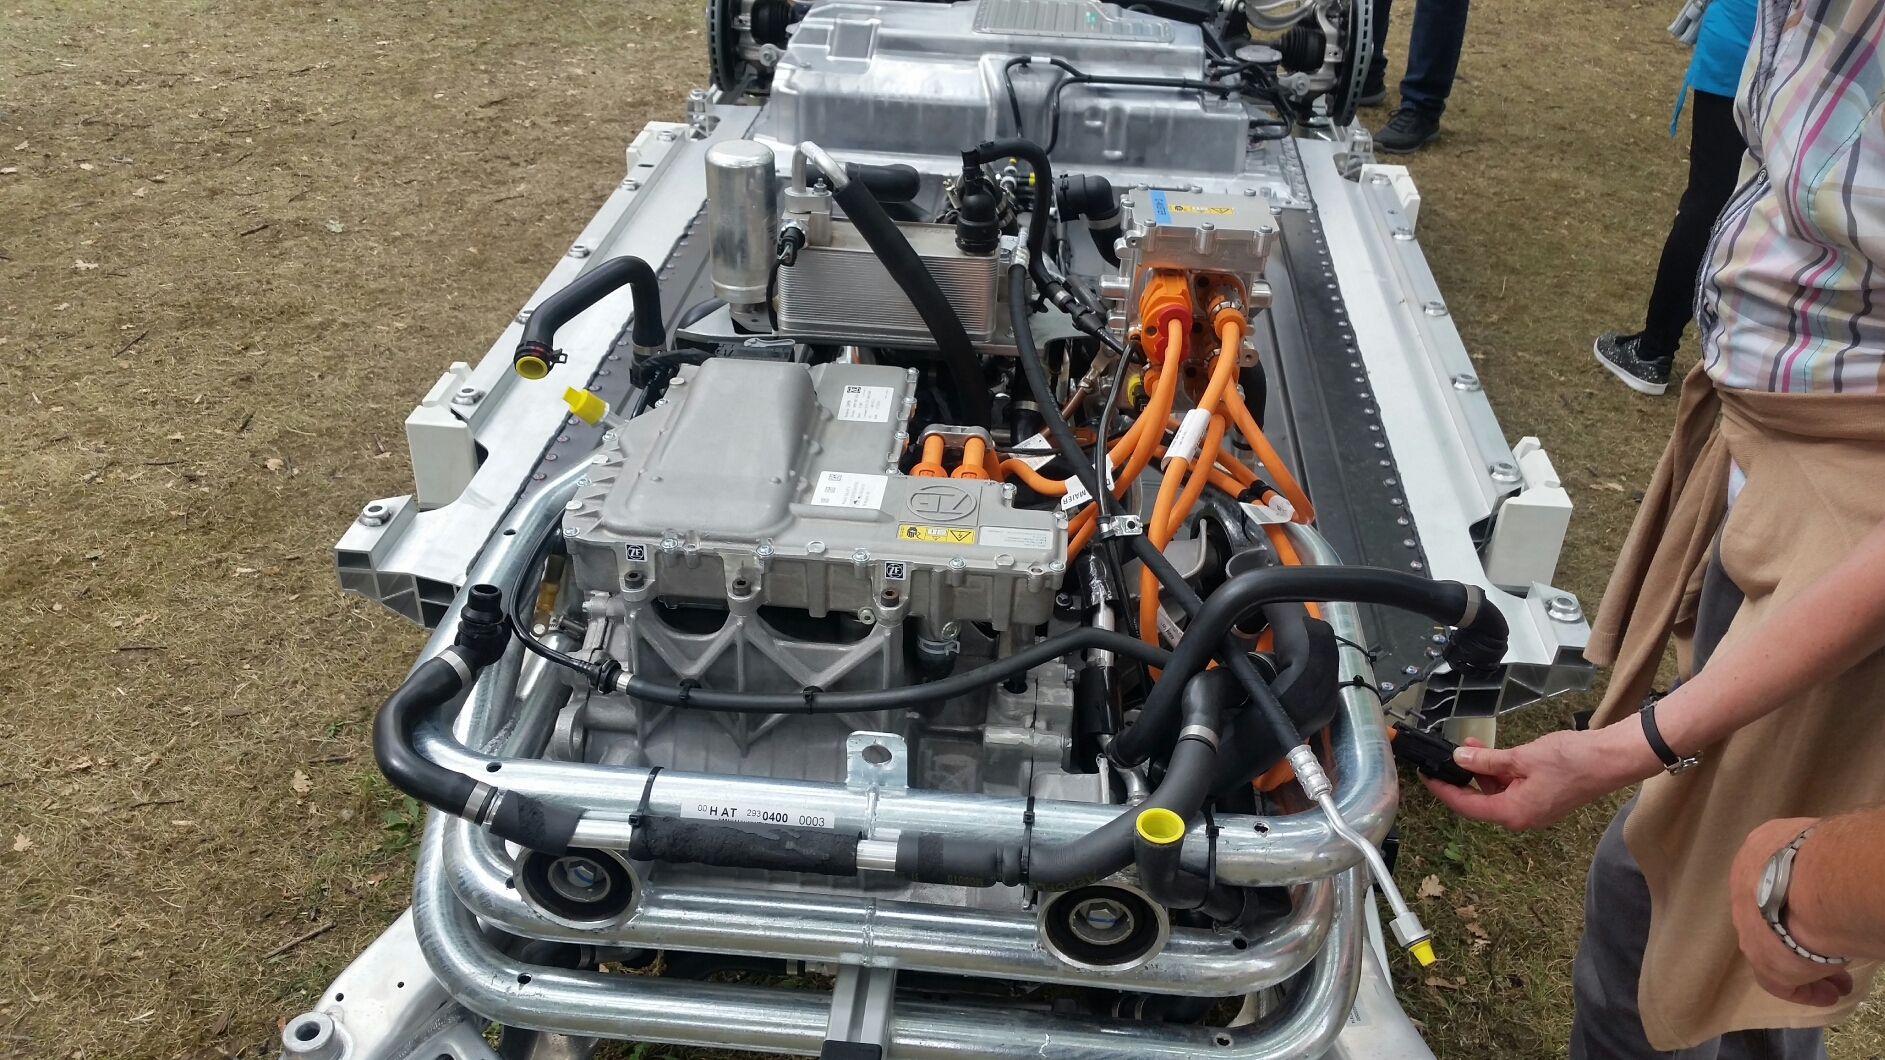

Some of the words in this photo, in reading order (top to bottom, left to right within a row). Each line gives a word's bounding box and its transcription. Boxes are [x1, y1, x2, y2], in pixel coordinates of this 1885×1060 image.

[1062, 489, 1087, 505] MAIER
[627, 547, 643, 558] ZF
[887, 565, 902, 576] ZF
[798, 815, 825, 827] 0003
[1028, 873, 1100, 892] AEROFLE
